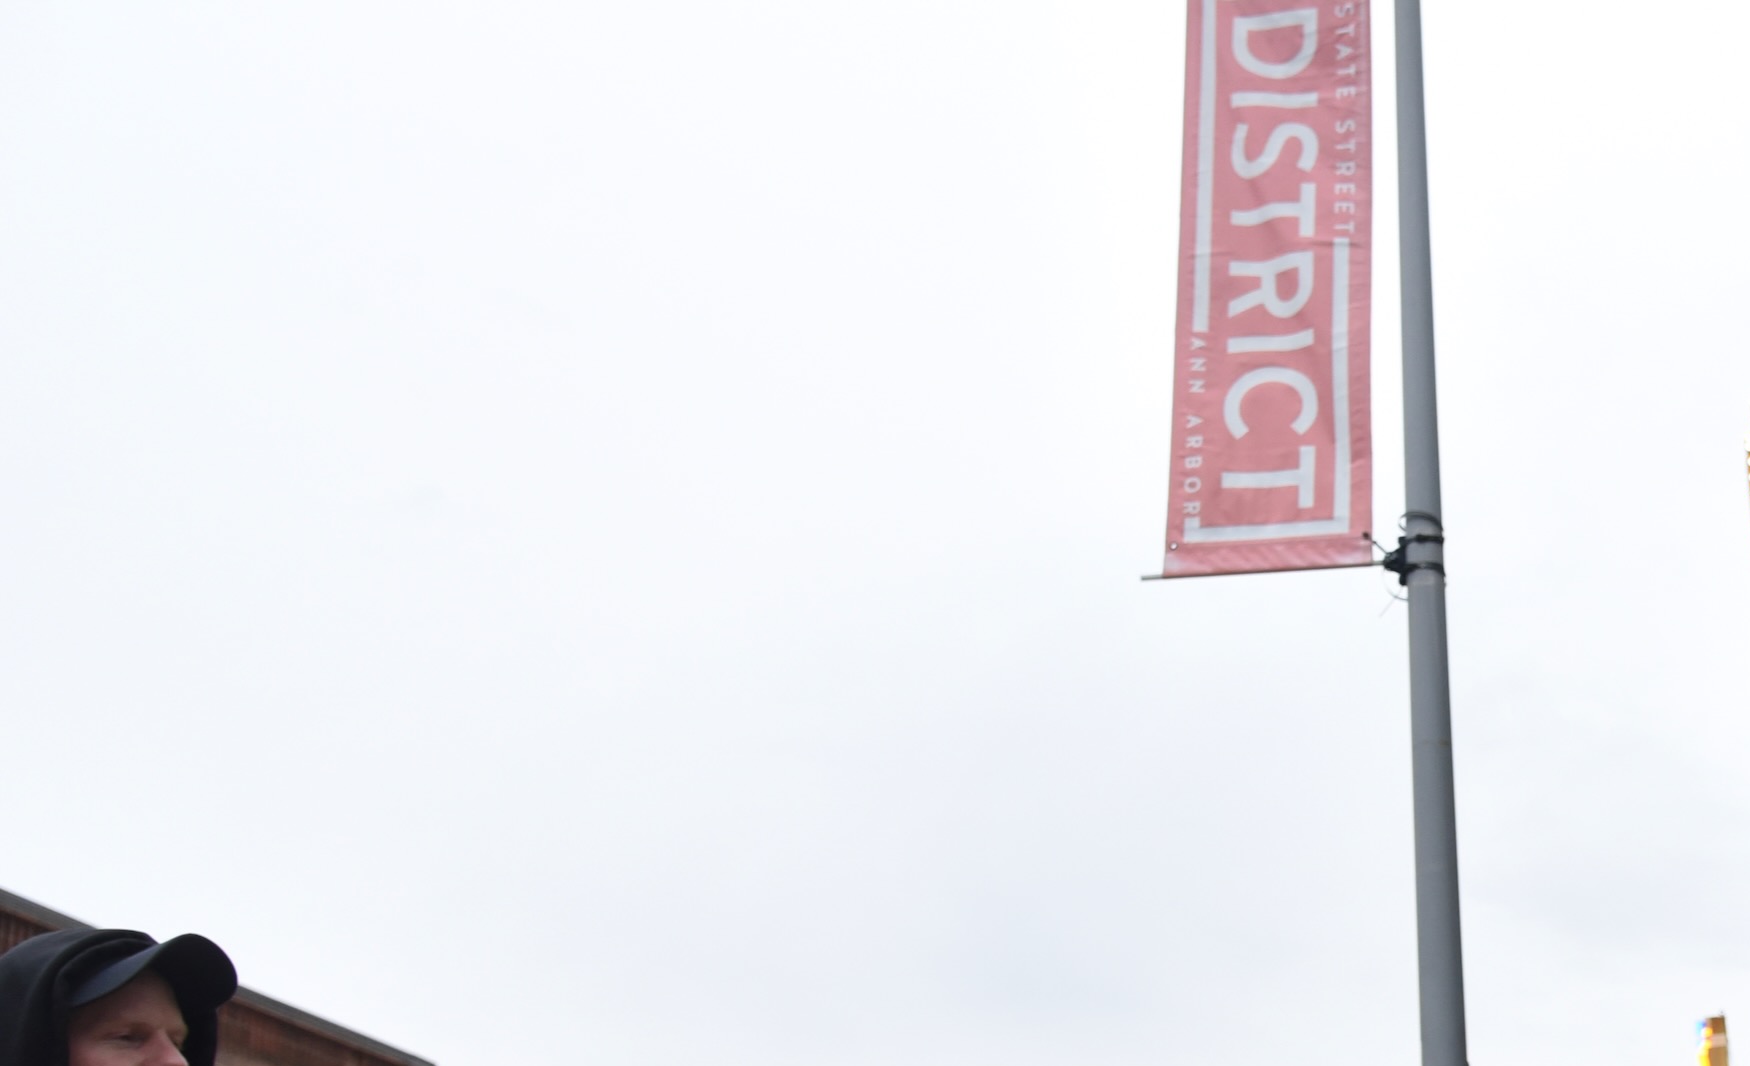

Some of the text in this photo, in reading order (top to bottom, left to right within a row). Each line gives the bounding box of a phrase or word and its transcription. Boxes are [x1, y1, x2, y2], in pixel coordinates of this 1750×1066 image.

[1334, 2, 1357, 234] STATE STREET
[1220, 5, 1320, 509] DISTRICT
[1183, 337, 1207, 515] ANN ARBOR
